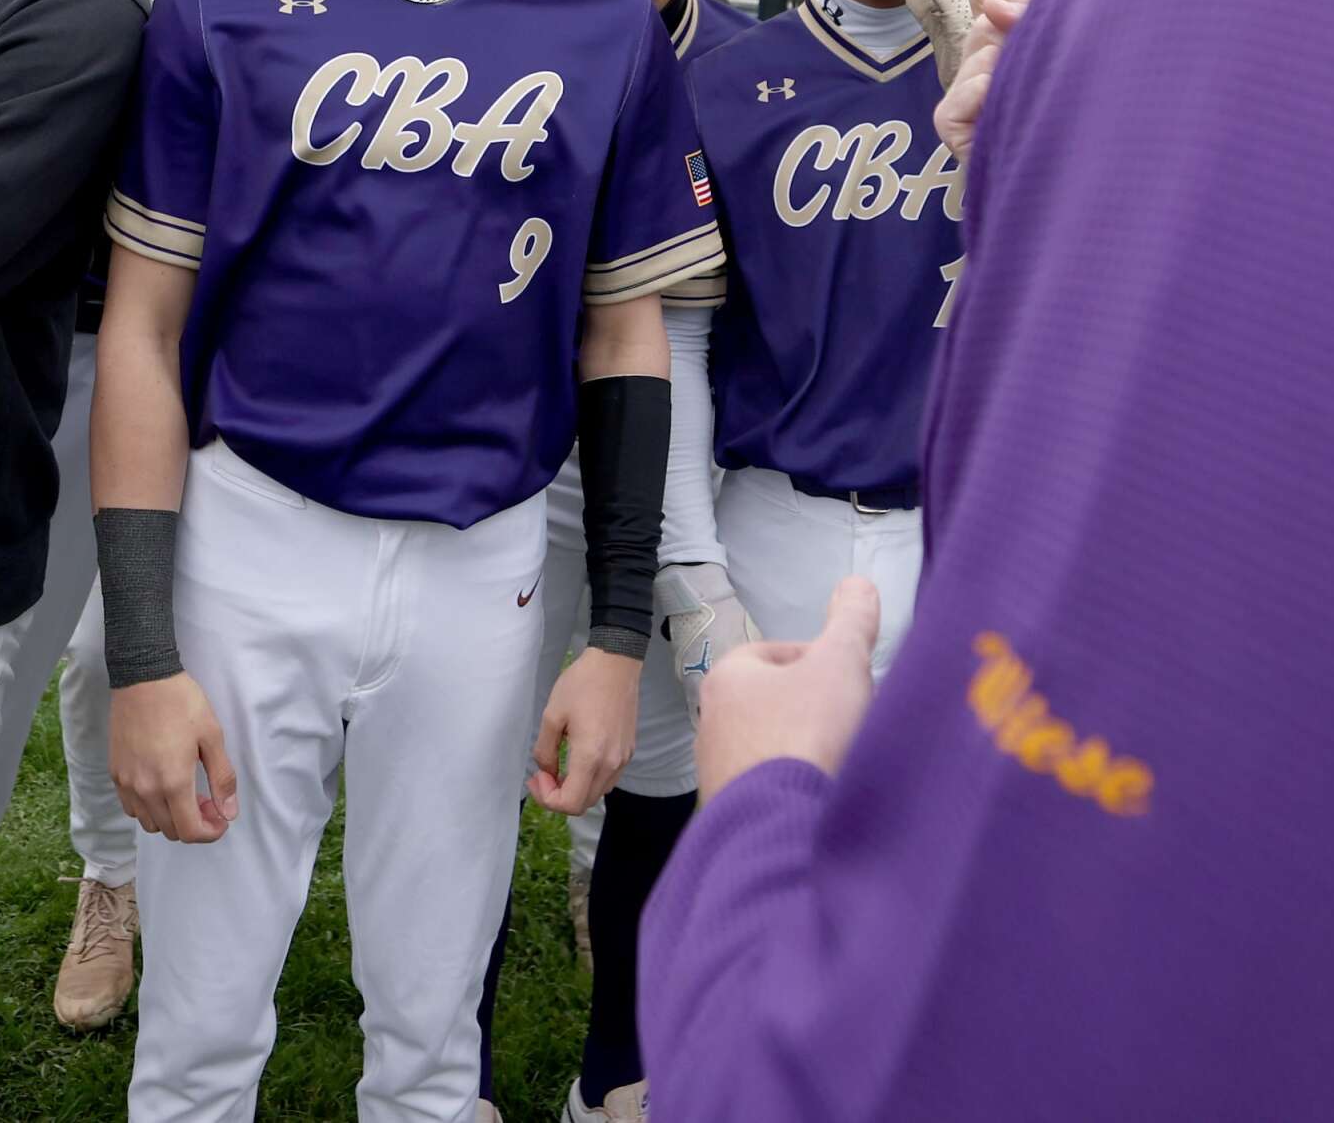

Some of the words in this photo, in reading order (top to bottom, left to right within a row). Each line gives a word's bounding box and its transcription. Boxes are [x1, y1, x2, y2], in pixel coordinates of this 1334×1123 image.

[291, 52, 564, 182] CBA
[773, 119, 966, 227] CBA
[498, 217, 553, 304] 9
